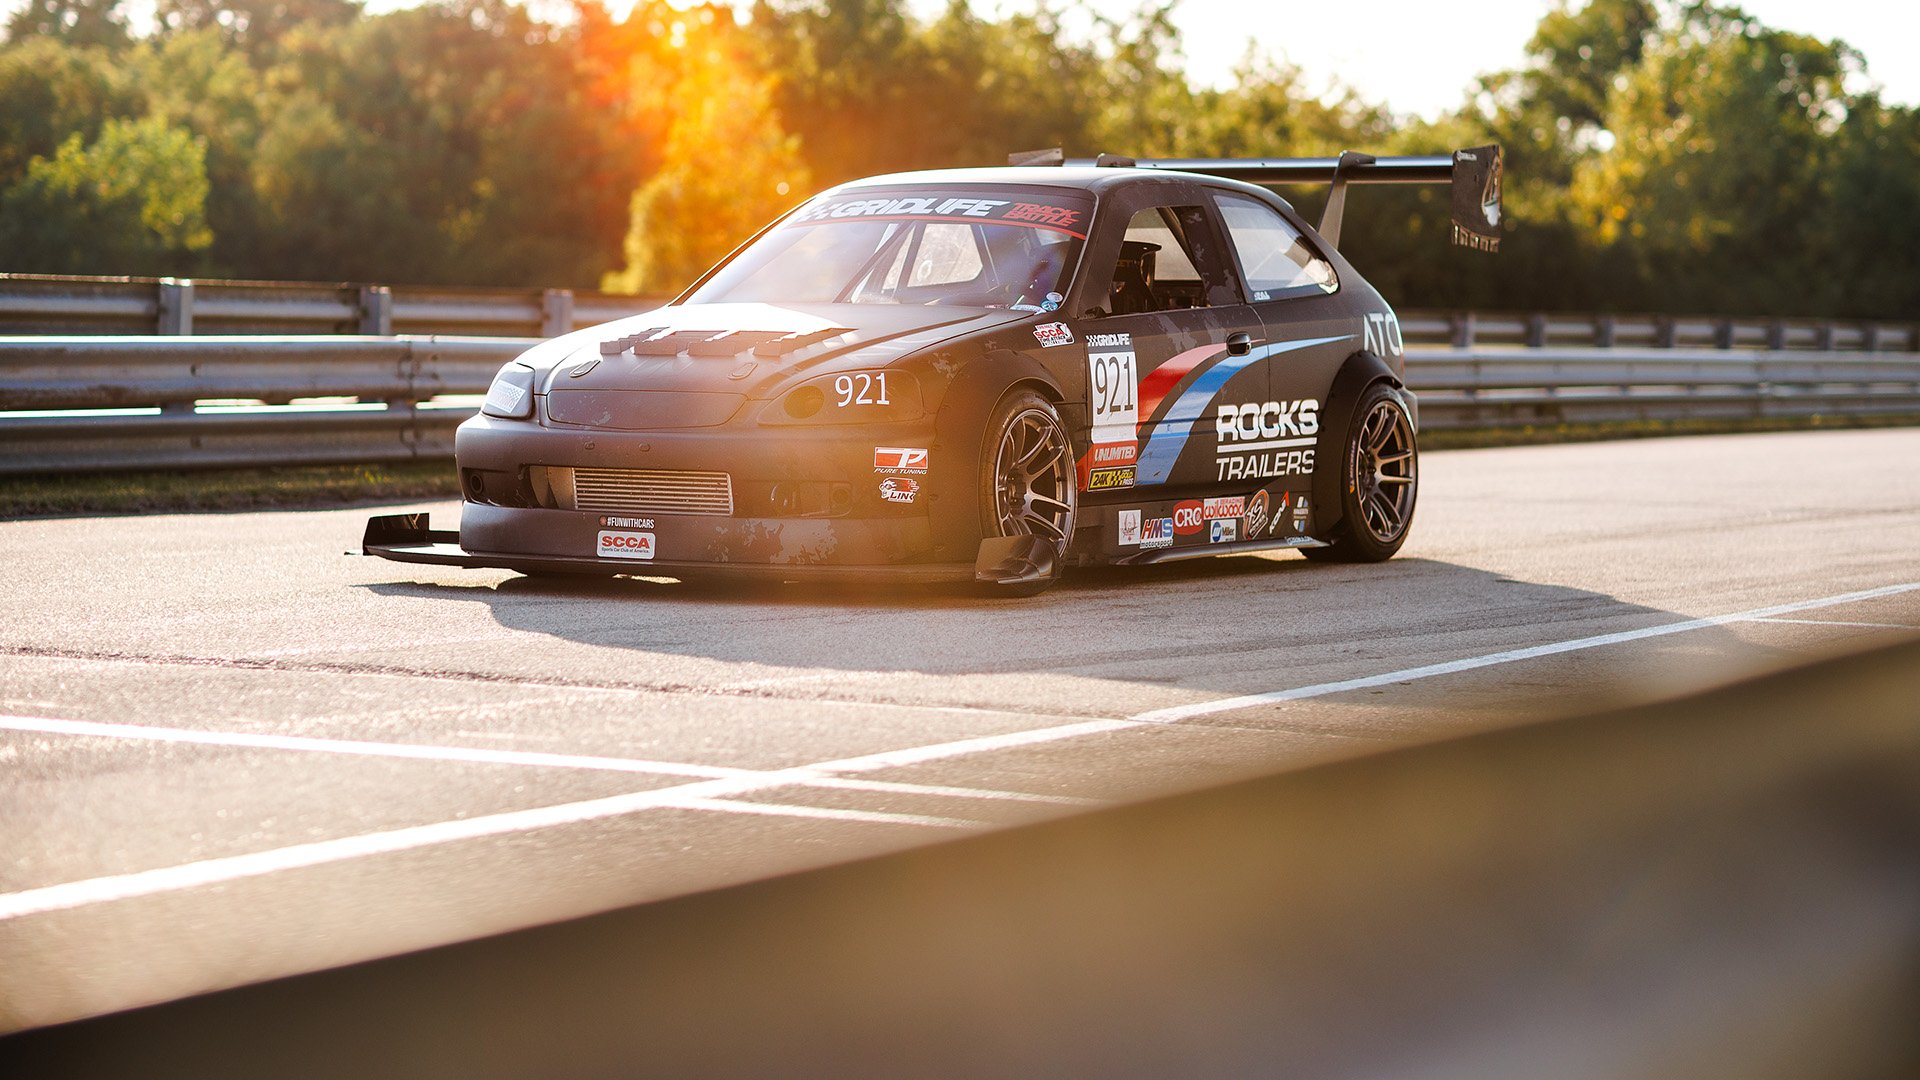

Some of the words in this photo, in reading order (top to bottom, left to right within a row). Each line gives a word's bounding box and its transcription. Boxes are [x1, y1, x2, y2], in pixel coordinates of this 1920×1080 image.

[831, 198, 1010, 217] GRIDLIFE
[1009, 203, 1081, 217] TRACK
[1002, 211, 1079, 227] BATTLE
[1035, 328, 1064, 338] SCCA
[1096, 334, 1130, 347] GRIDLIFE
[835, 373, 890, 407] 921
[1095, 356, 1134, 416] 921
[1216, 399, 1319, 442] ROCKS
[1094, 445, 1136, 462] UNLIMITED
[1216, 450, 1315, 481] TRAILERS
[1092, 472, 1110, 487] 24K
[607, 516, 655, 529] #FUNWITHCARS
[1175, 508, 1202, 527] CRC
[1141, 518, 1173, 539] HMS
[601, 535, 650, 549] SCCA
[1140, 539, 1174, 549] motorsport
